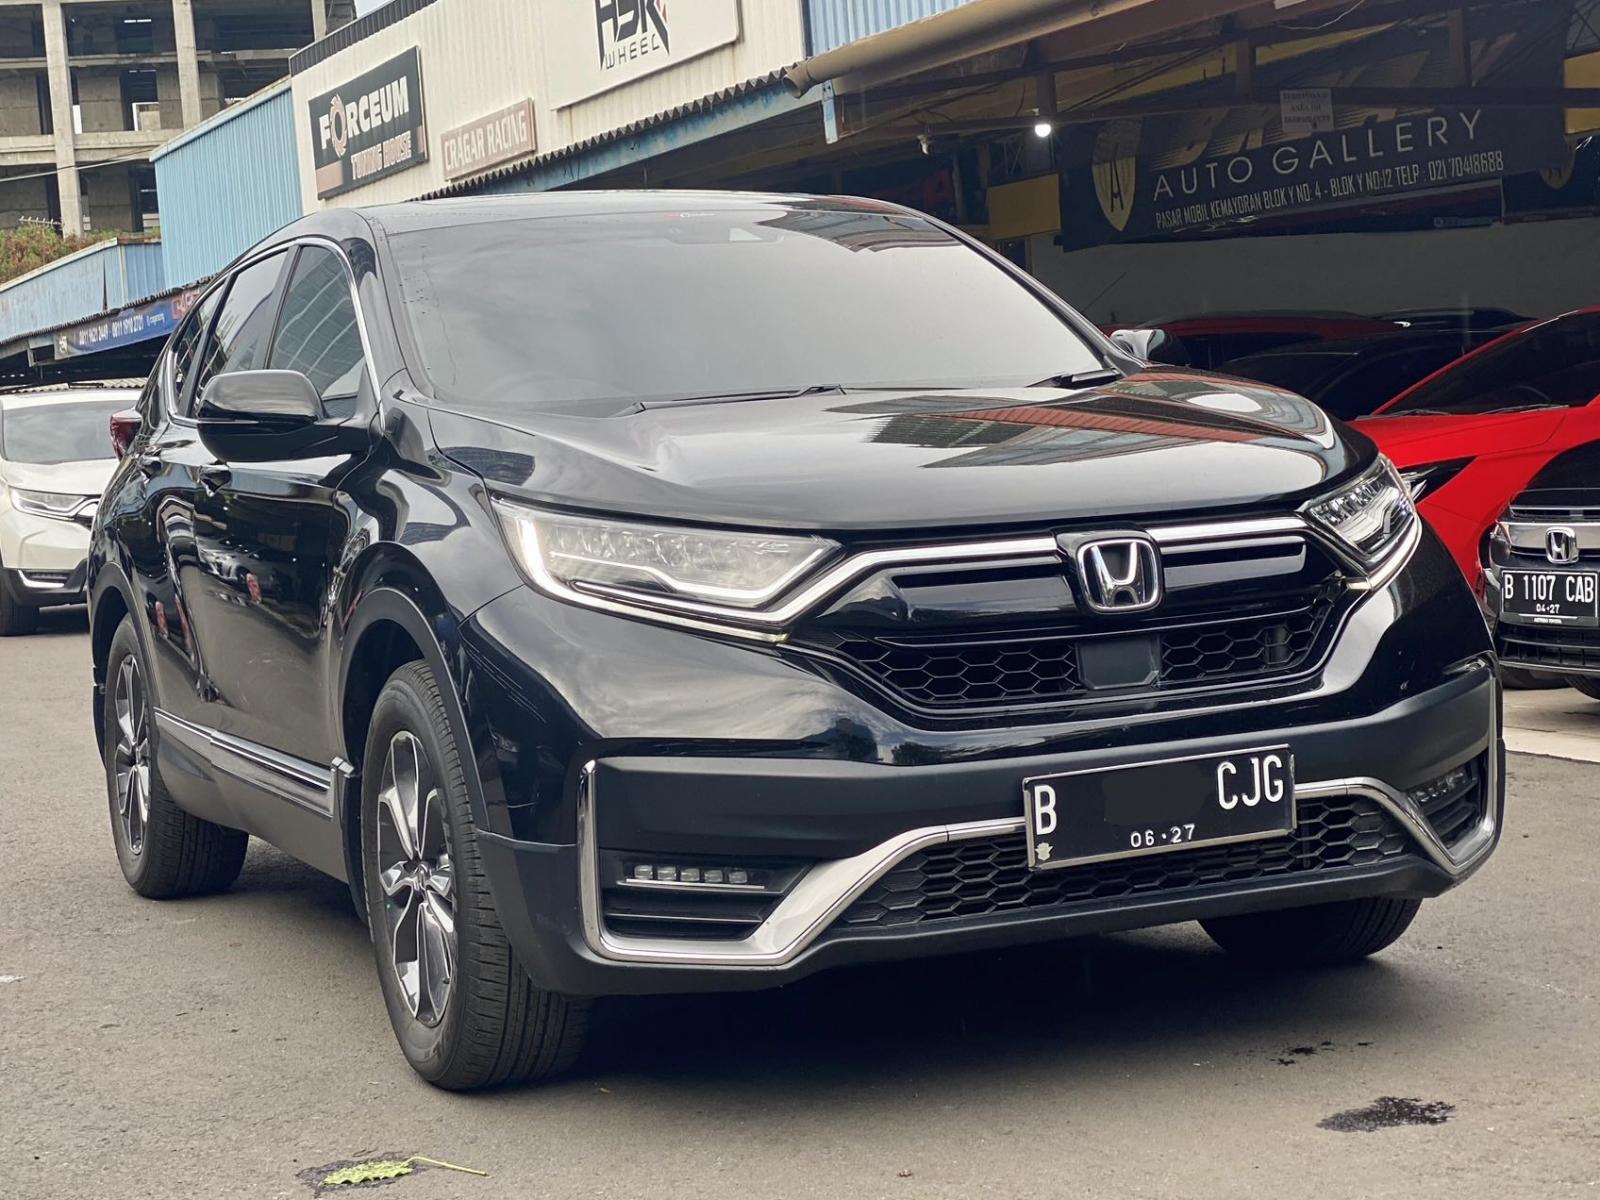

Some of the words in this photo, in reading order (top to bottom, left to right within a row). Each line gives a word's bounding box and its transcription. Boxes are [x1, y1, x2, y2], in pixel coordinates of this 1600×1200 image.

[605, 33, 660, 70] WHEEL
[319, 76, 409, 158] FORCEUM
[443, 127, 485, 171] CRAGAR
[486, 109, 528, 155] RACING
[1153, 156, 1253, 201] AUTO
[1272, 109, 1482, 175] GALLERY
[1156, 207, 1183, 229] PASAR
[1184, 203, 1210, 225] MOBIL
[1210, 191, 1263, 219] KEMAYORAN
[1263, 188, 1289, 209] BLOK
[1288, 187, 1296, 205] Y
[1313, 181, 1322, 200] 4
[1330, 174, 1356, 197] BLOK
[1356, 172, 1364, 193] Y
[1394, 164, 1420, 186] TELP
[1428, 159, 1447, 181] 021
[1504, 574, 1514, 599] B
[1523, 575, 1556, 600] 1107
[1565, 576, 1594, 603] CAB
[1034, 784, 1057, 835] B
[1216, 755, 1284, 810] CJG
